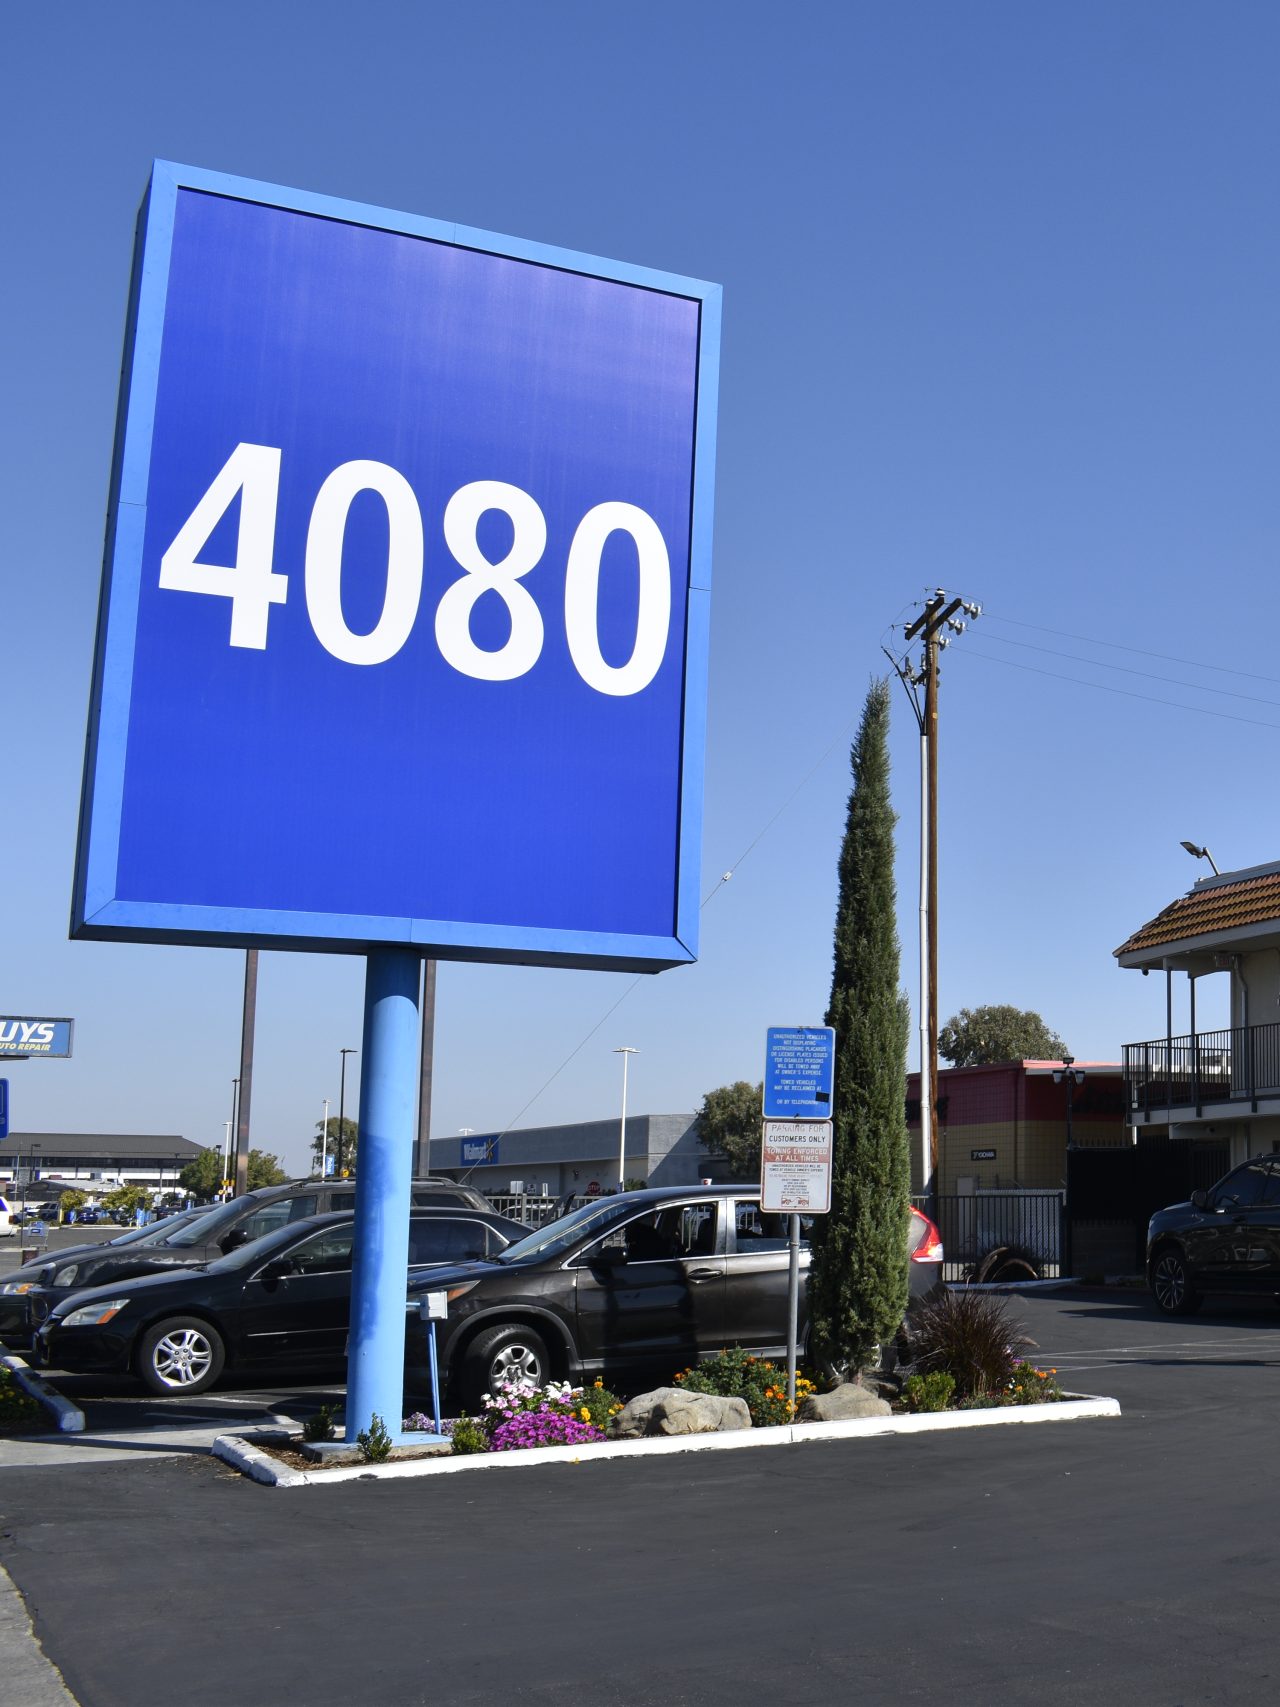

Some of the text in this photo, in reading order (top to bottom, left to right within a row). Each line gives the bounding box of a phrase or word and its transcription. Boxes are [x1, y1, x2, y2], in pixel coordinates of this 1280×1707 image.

[159, 442, 671, 696] 4080
[18, 1043, 51, 1051] REPAIR
[771, 1124, 824, 1132] PARKING FOR
[464, 1142, 486, 1160] Walmart
